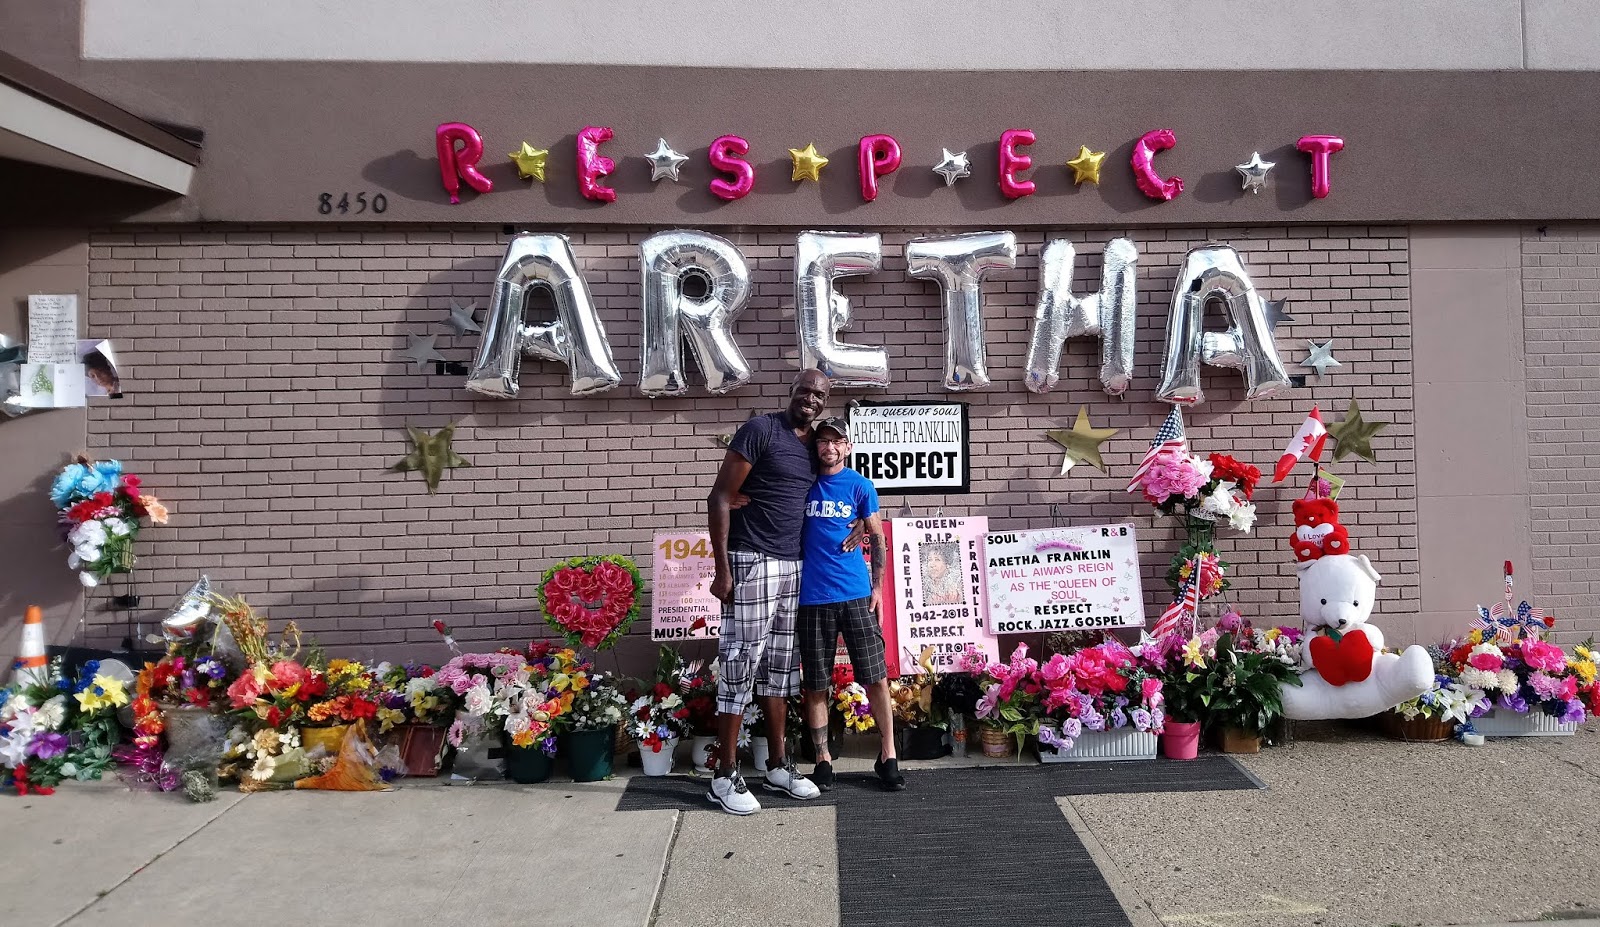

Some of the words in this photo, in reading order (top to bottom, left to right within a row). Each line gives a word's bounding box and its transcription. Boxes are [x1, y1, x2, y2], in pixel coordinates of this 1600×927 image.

[318, 192, 387, 214] 8450
[466, 229, 1292, 403] ARETHA
[882, 407, 916, 417] QUEEN
[918, 407, 931, 416] OF
[933, 407, 960, 416] SOUL
[853, 421, 900, 444] ARETHA
[903, 421, 960, 443] FRANKLIN
[855, 451, 957, 480] RESPECT
[915, 519, 957, 529] QUEEN
[987, 534, 1018, 545] SOUL
[1101, 527, 1128, 537] R&B
[989, 554, 1040, 567] ARETHA
[1047, 549, 1111, 562] FRANKLIN
[662, 561, 692, 572] Aretha
[697, 561, 716, 571] Fran
[1000, 568, 1027, 579] WILL
[1078, 562, 1114, 574] REIGN
[902, 542, 915, 610] ARETHA
[968, 540, 983, 628] FRANKLIN
[1010, 582, 1025, 592] AS
[1029, 580, 1051, 591] THE
[1102, 577, 1117, 587] OF
[658, 605, 710, 614] PRESIDENTIAL
[909, 608, 970, 623] 1942-2018
[1034, 604, 1092, 615] RESPECT
[660, 615, 686, 623] MEDAL
[703, 614, 720, 622] FREE
[654, 627, 696, 638] MUSIC
[705, 626, 722, 636] IC
[910, 625, 965, 638] RESPECT
[912, 655, 954, 666] LVES
